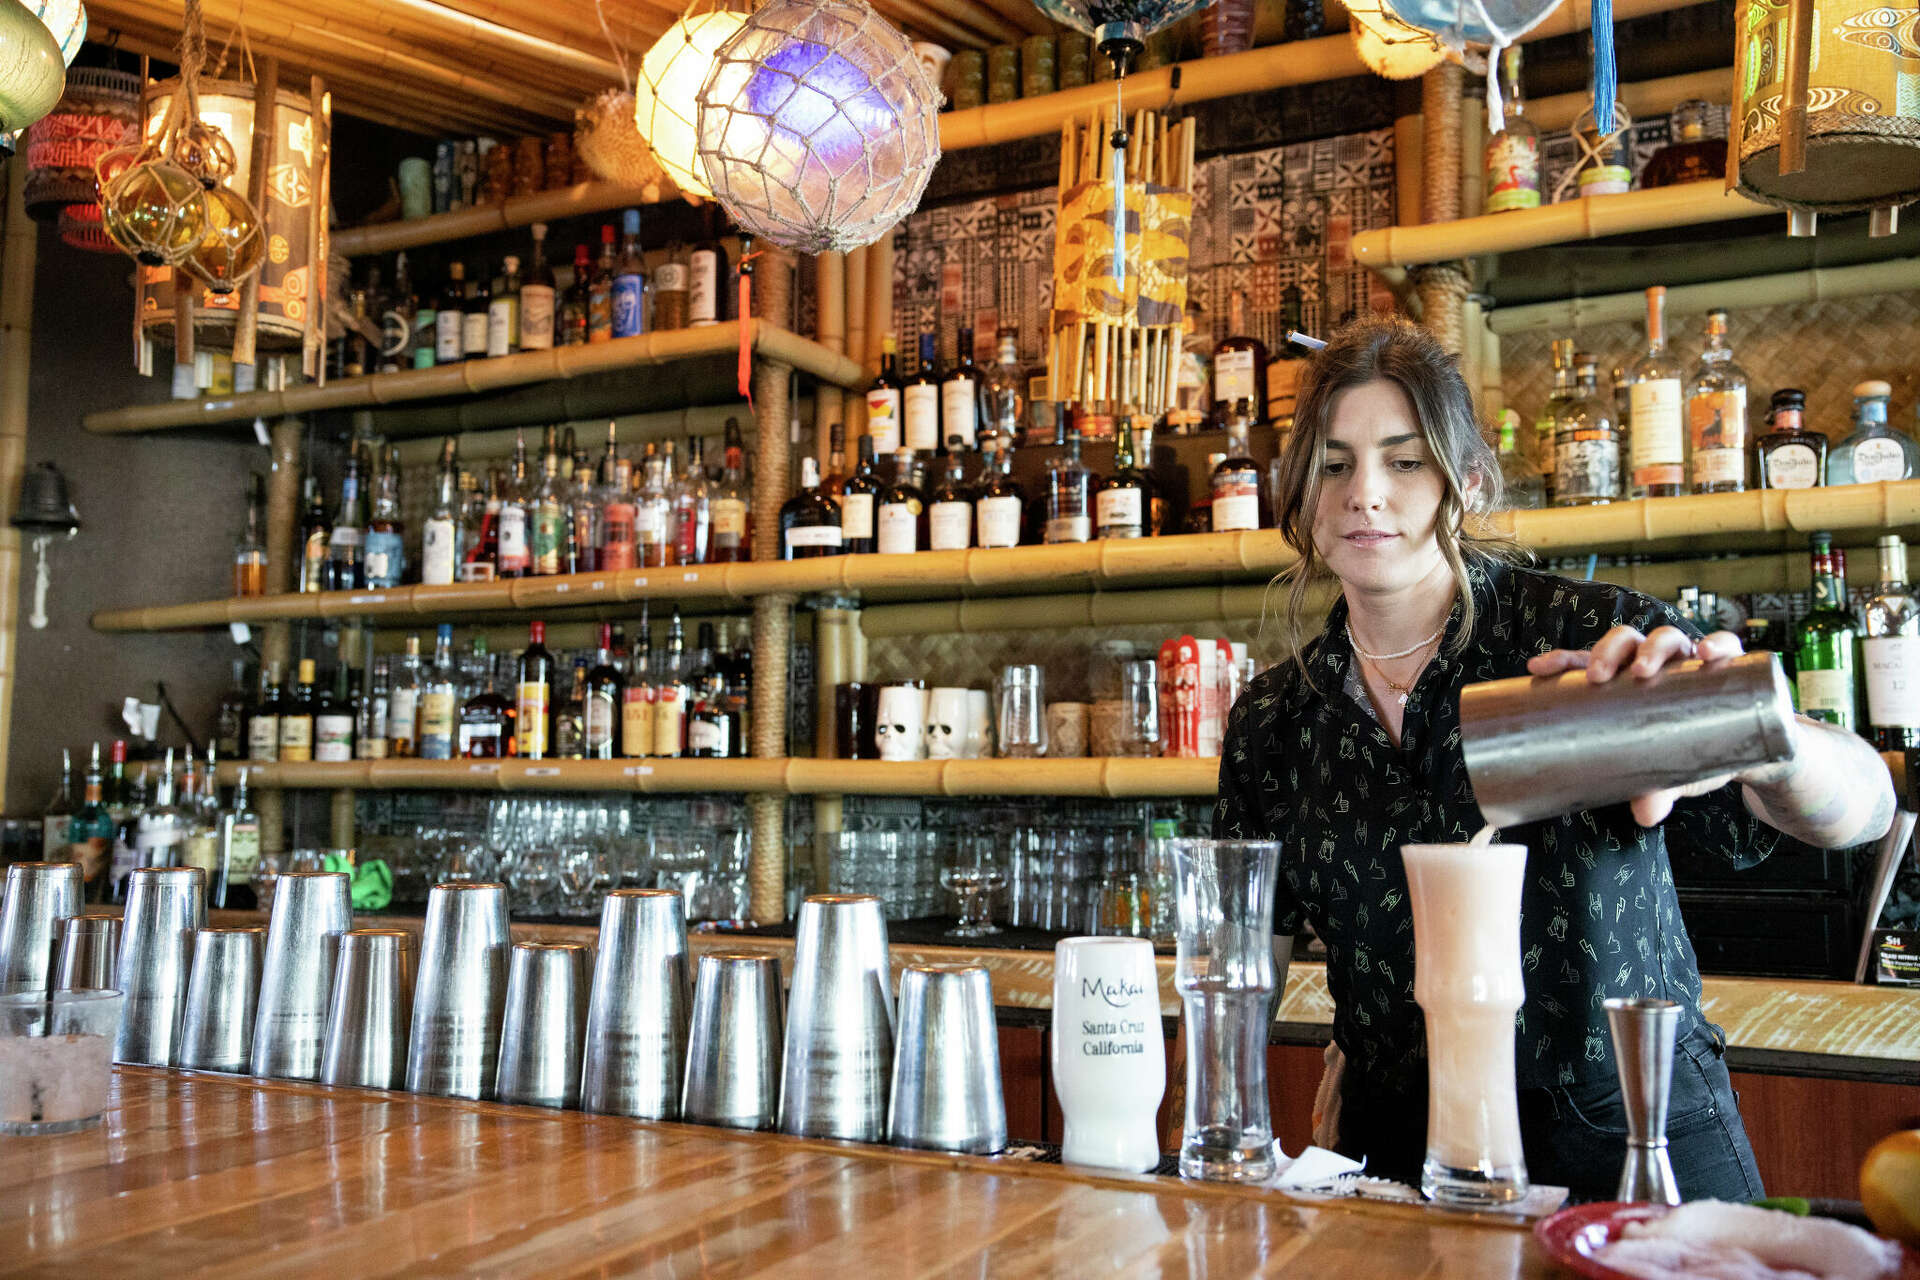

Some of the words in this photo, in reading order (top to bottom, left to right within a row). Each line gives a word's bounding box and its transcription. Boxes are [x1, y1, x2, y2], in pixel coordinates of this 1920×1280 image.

[1082, 976, 1145, 1007] Makai
[1082, 1020, 1117, 1035] Santa
[1120, 1019, 1145, 1034] Cruz
[1083, 1040, 1144, 1056] California
